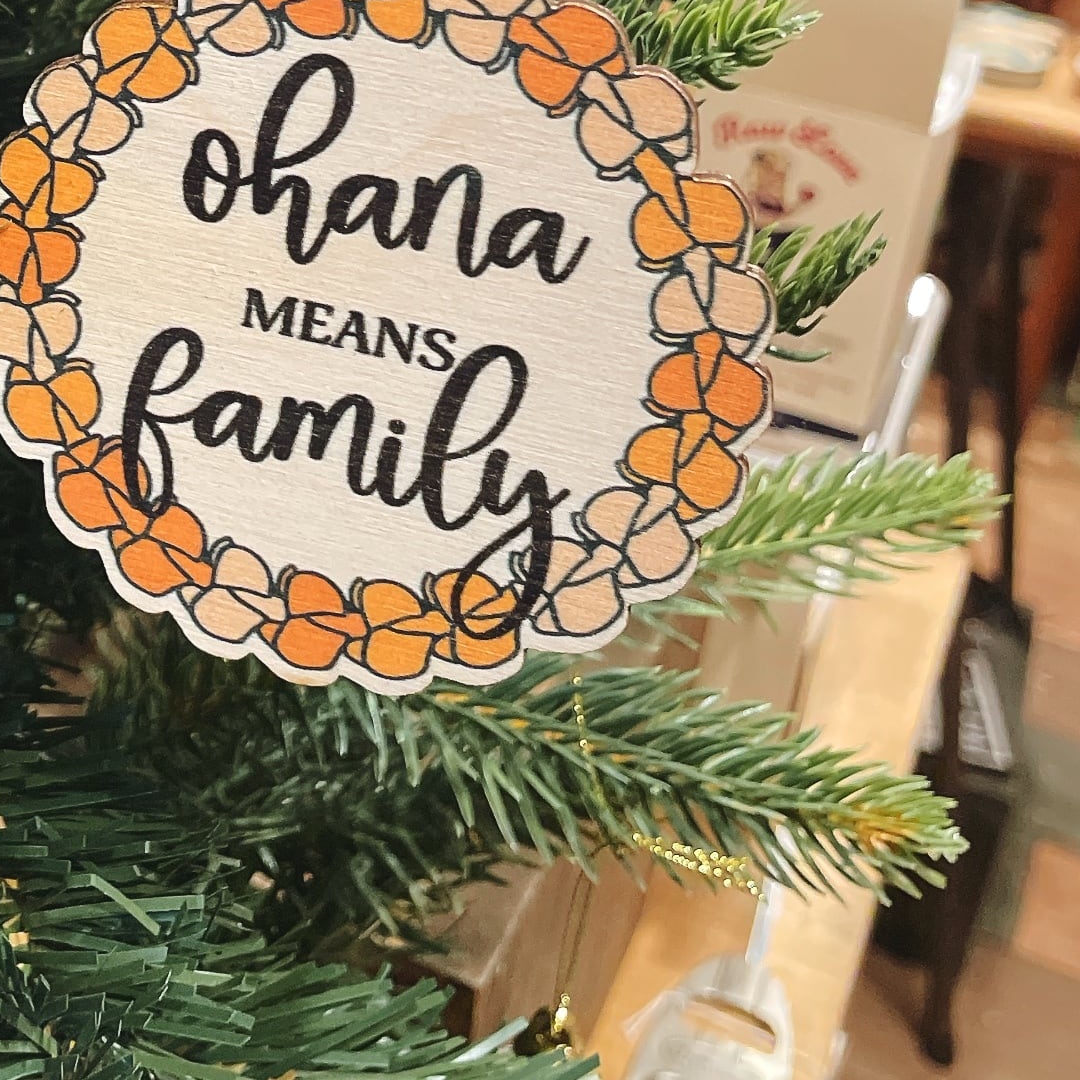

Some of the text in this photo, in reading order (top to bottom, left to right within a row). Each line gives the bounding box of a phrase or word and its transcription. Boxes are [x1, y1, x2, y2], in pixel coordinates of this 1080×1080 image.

[182, 53, 591, 284] ohana
[241, 287, 457, 372] MEANS
[122, 326, 572, 638] family
